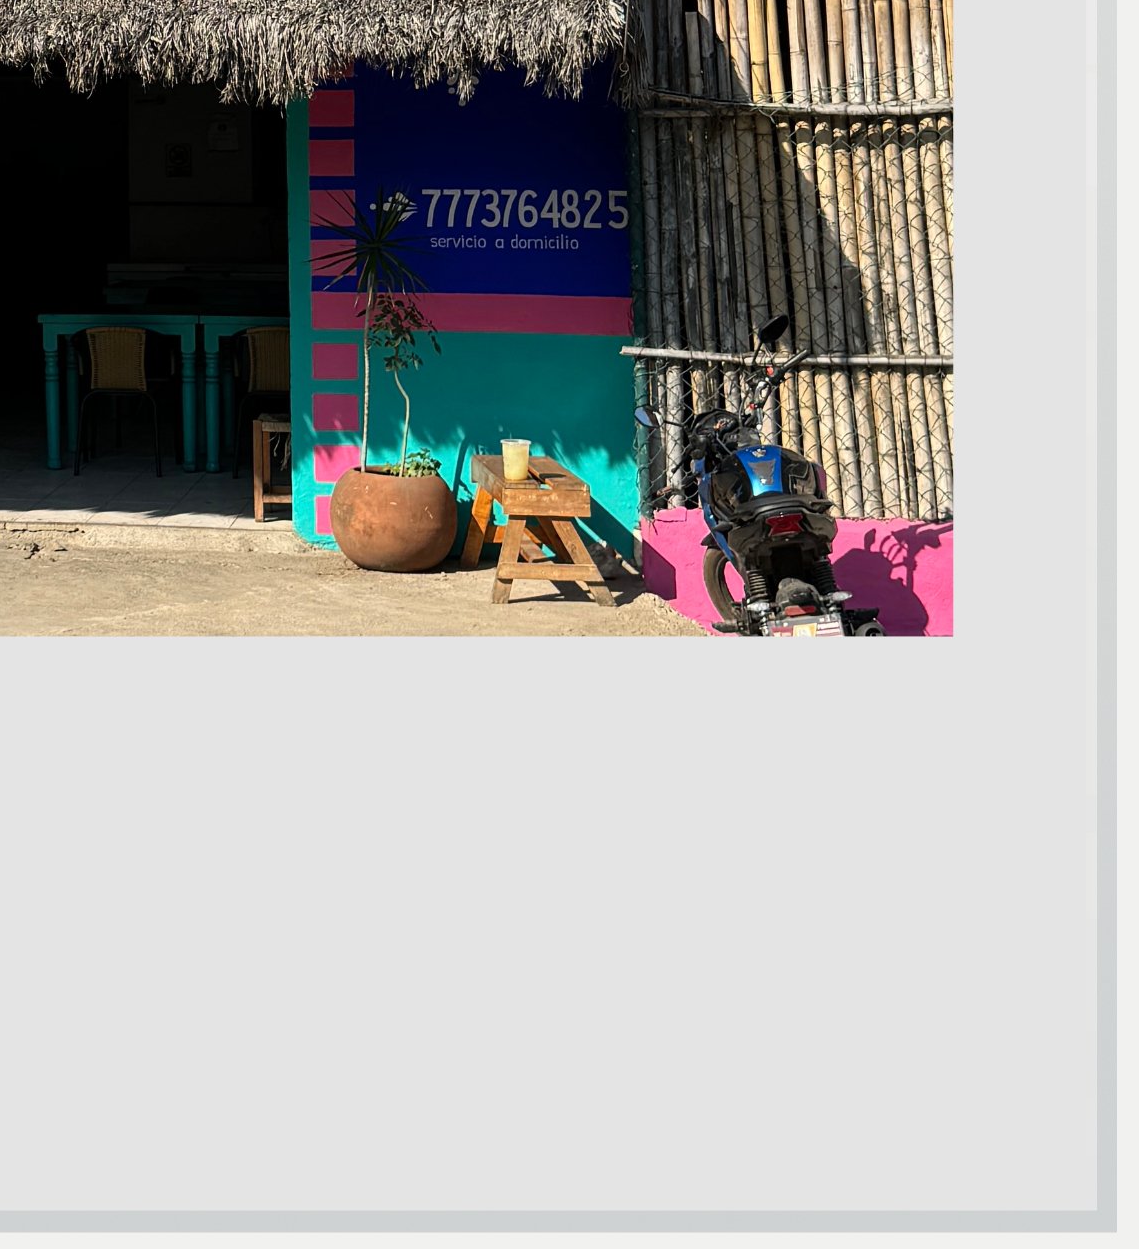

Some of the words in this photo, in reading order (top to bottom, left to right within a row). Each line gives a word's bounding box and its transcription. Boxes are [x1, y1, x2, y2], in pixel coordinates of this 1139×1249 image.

[421, 189, 629, 229] 7773764825
[430, 235, 487, 249] servicio
[494, 236, 505, 249] a
[510, 233, 579, 250] domicilio
